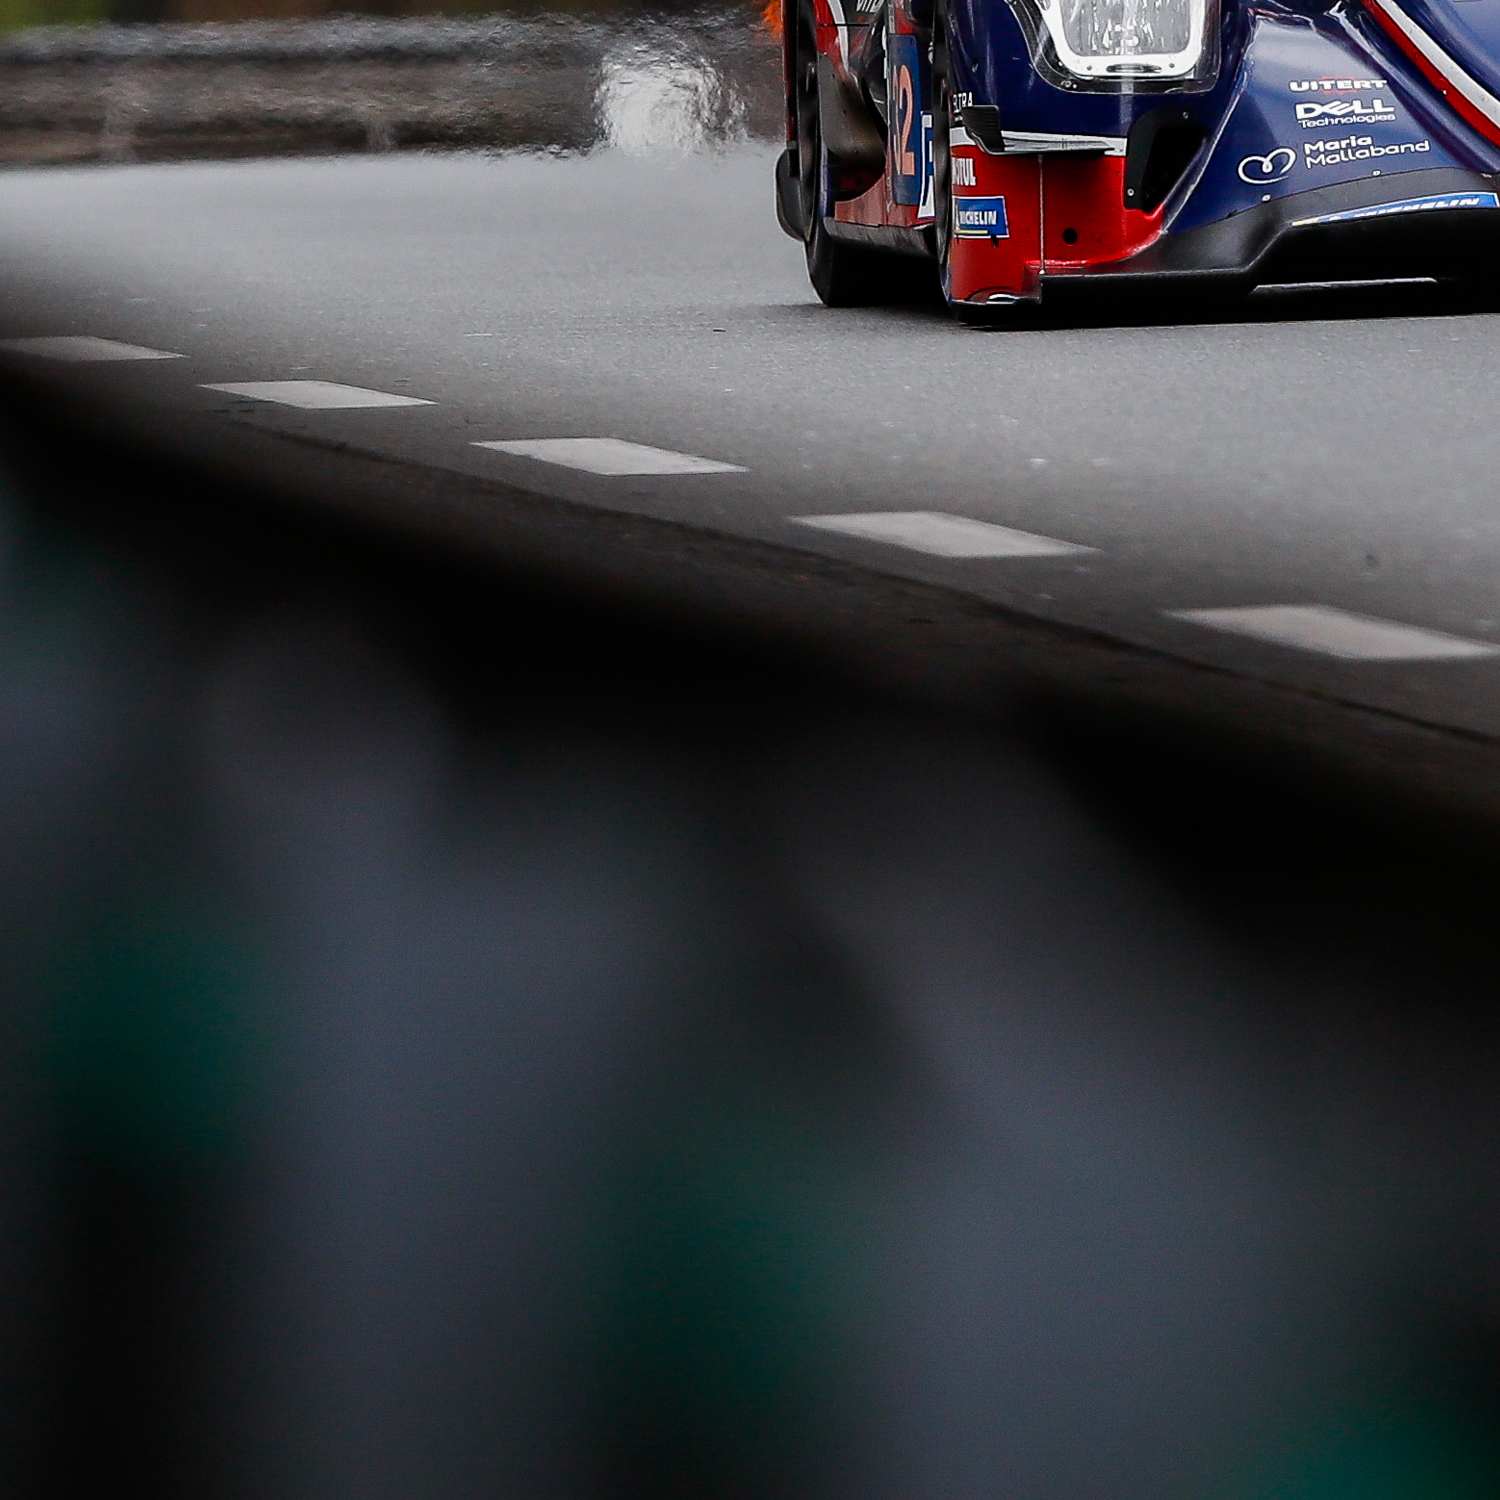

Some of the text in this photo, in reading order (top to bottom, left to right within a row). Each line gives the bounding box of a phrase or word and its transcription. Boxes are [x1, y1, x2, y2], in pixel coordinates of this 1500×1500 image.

[1289, 79, 1387, 92] UITERT
[1295, 99, 1395, 119] DELL
[1298, 114, 1396, 129] Technologies
[1304, 135, 1372, 155] Maria
[1306, 139, 1430, 169] Mallaband
